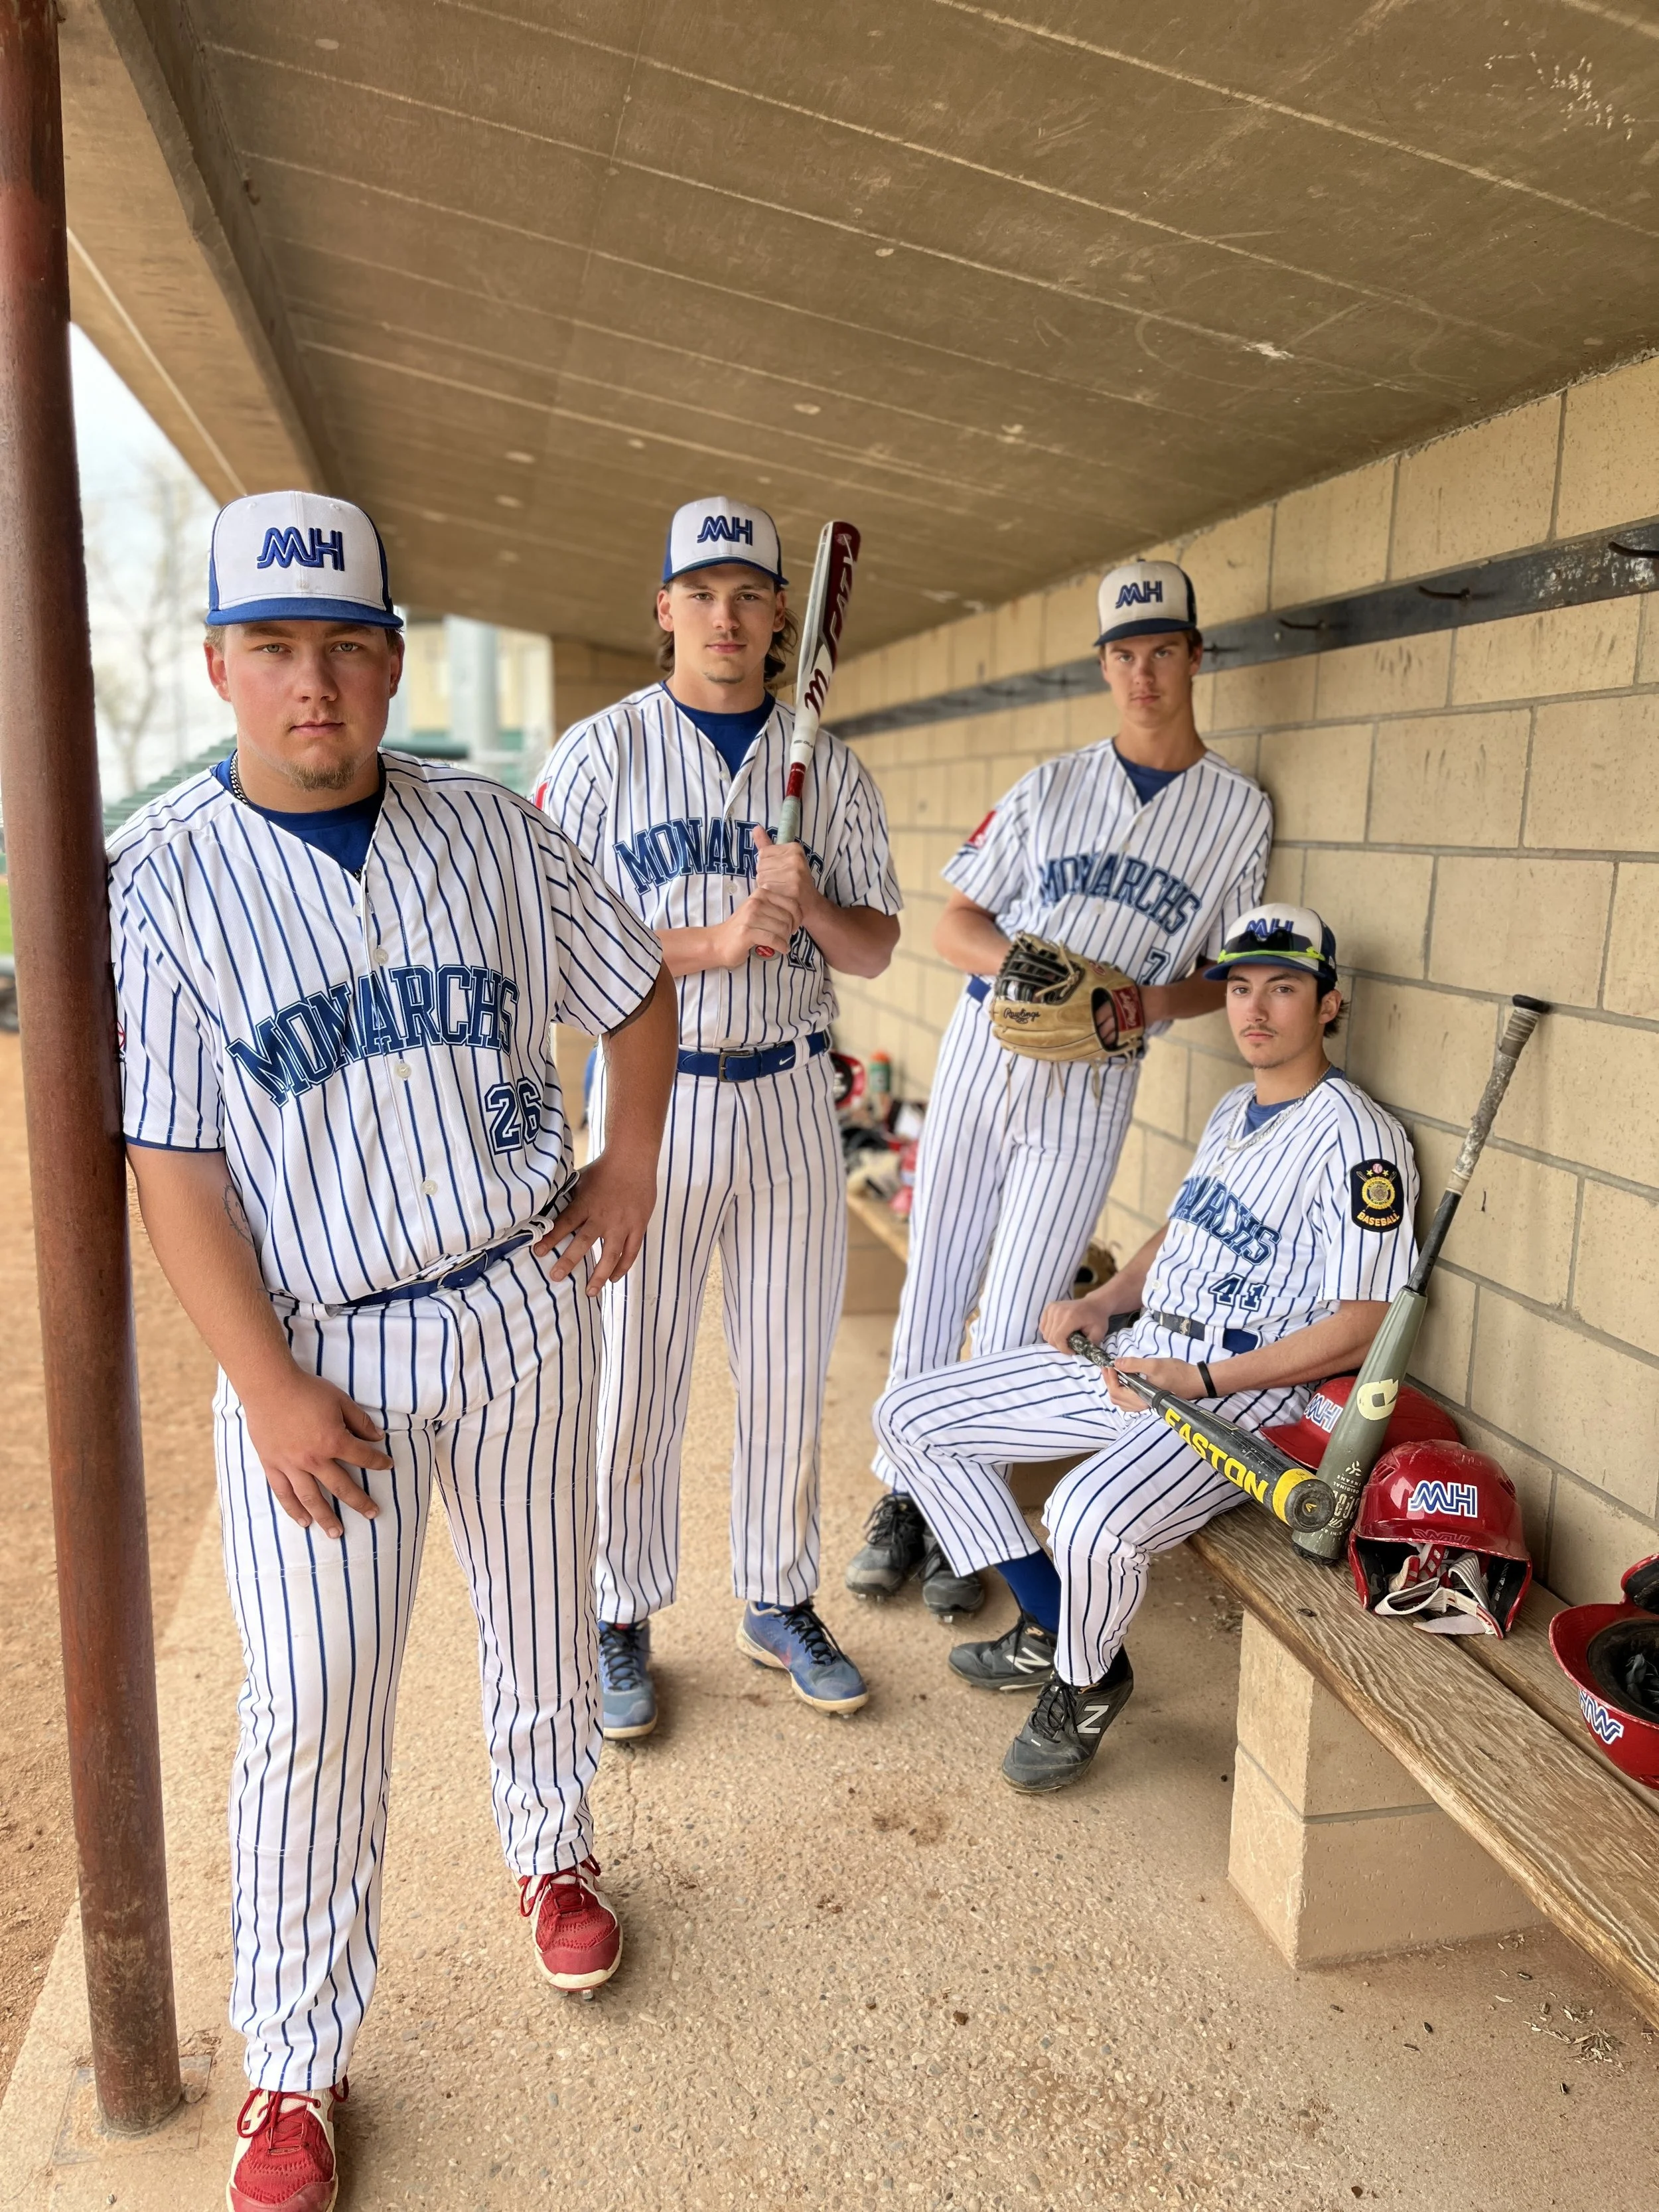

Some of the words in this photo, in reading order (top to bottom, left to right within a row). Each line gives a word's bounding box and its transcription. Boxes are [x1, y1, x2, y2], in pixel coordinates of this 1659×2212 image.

[256, 526, 345, 571] MH
[697, 515, 753, 546] MH
[1115, 580, 1163, 609] MH
[1039, 851, 1202, 936] MONARCHS
[225, 964, 519, 1108] MONARCHS
[484, 1076, 542, 1154] 26
[1356, 1211, 1400, 1226] BASEBALL
[1208, 1272, 1269, 1312] 41
[1165, 1408, 1269, 1504] EASTON
[1407, 1480, 1478, 1518] MH
